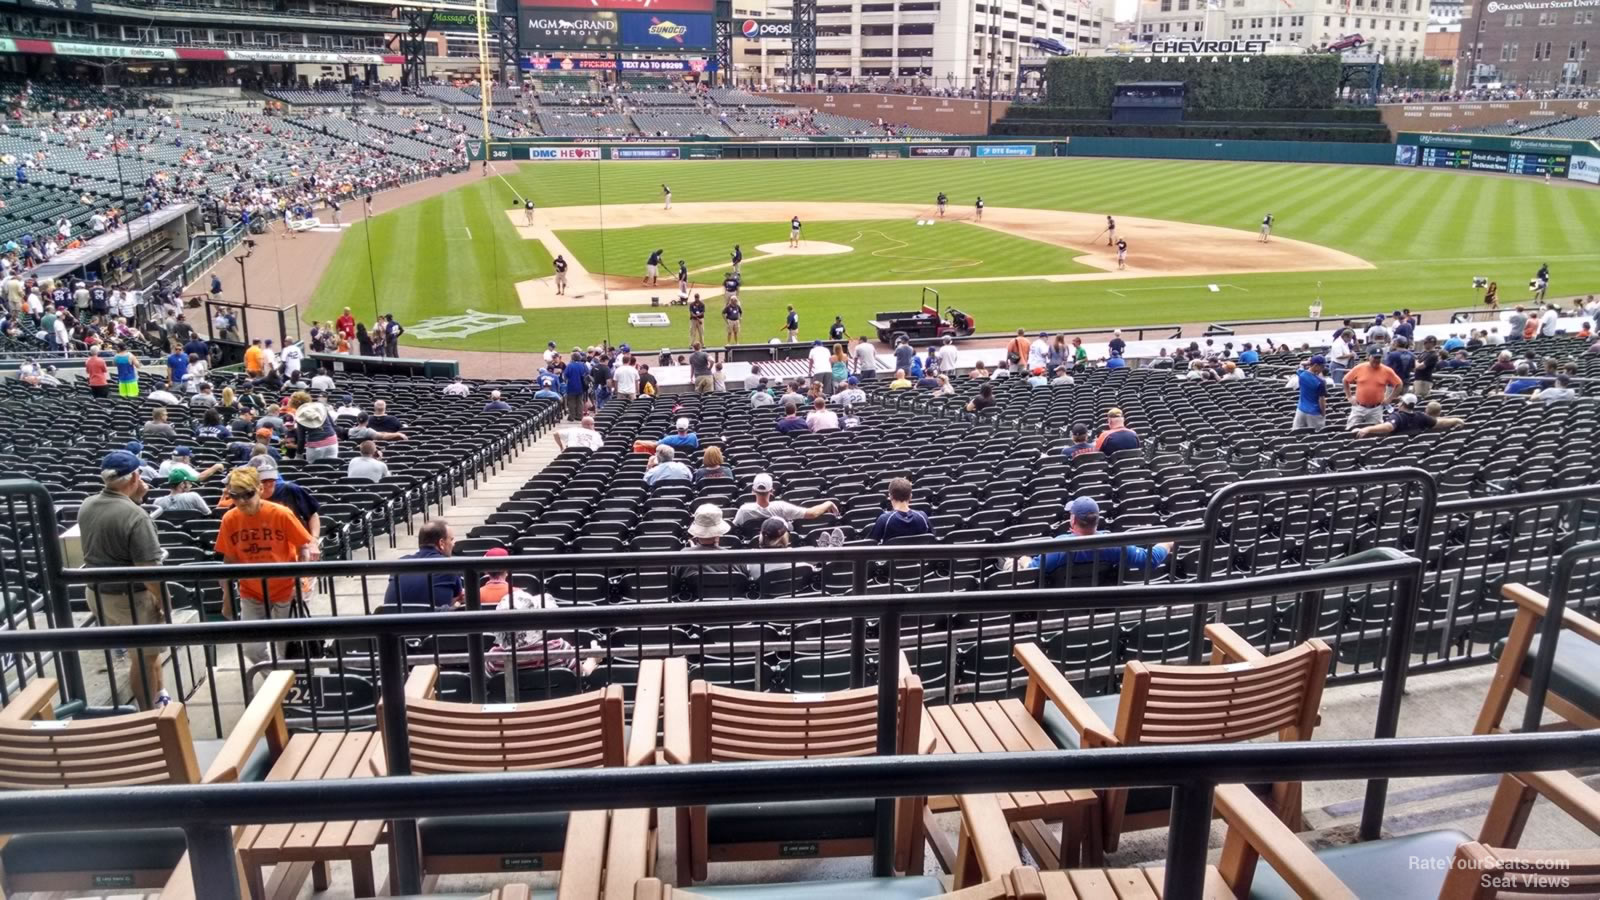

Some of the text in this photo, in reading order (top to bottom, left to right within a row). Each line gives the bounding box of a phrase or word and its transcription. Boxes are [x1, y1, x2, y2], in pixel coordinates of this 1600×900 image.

[433, 13, 491, 25] Massage Grn
[529, 19, 615, 30] MGM GRAND
[650, 26, 686, 34] SUNOCO
[760, 23, 792, 35] pepsi
[1152, 40, 1271, 53] CHEVROLET
[622, 61, 639, 69] TEXT
[640, 61, 650, 69] A3
[1539, 101, 1548, 109] 11
[1577, 101, 1589, 109] 42
[532, 150, 557, 158] DMC
